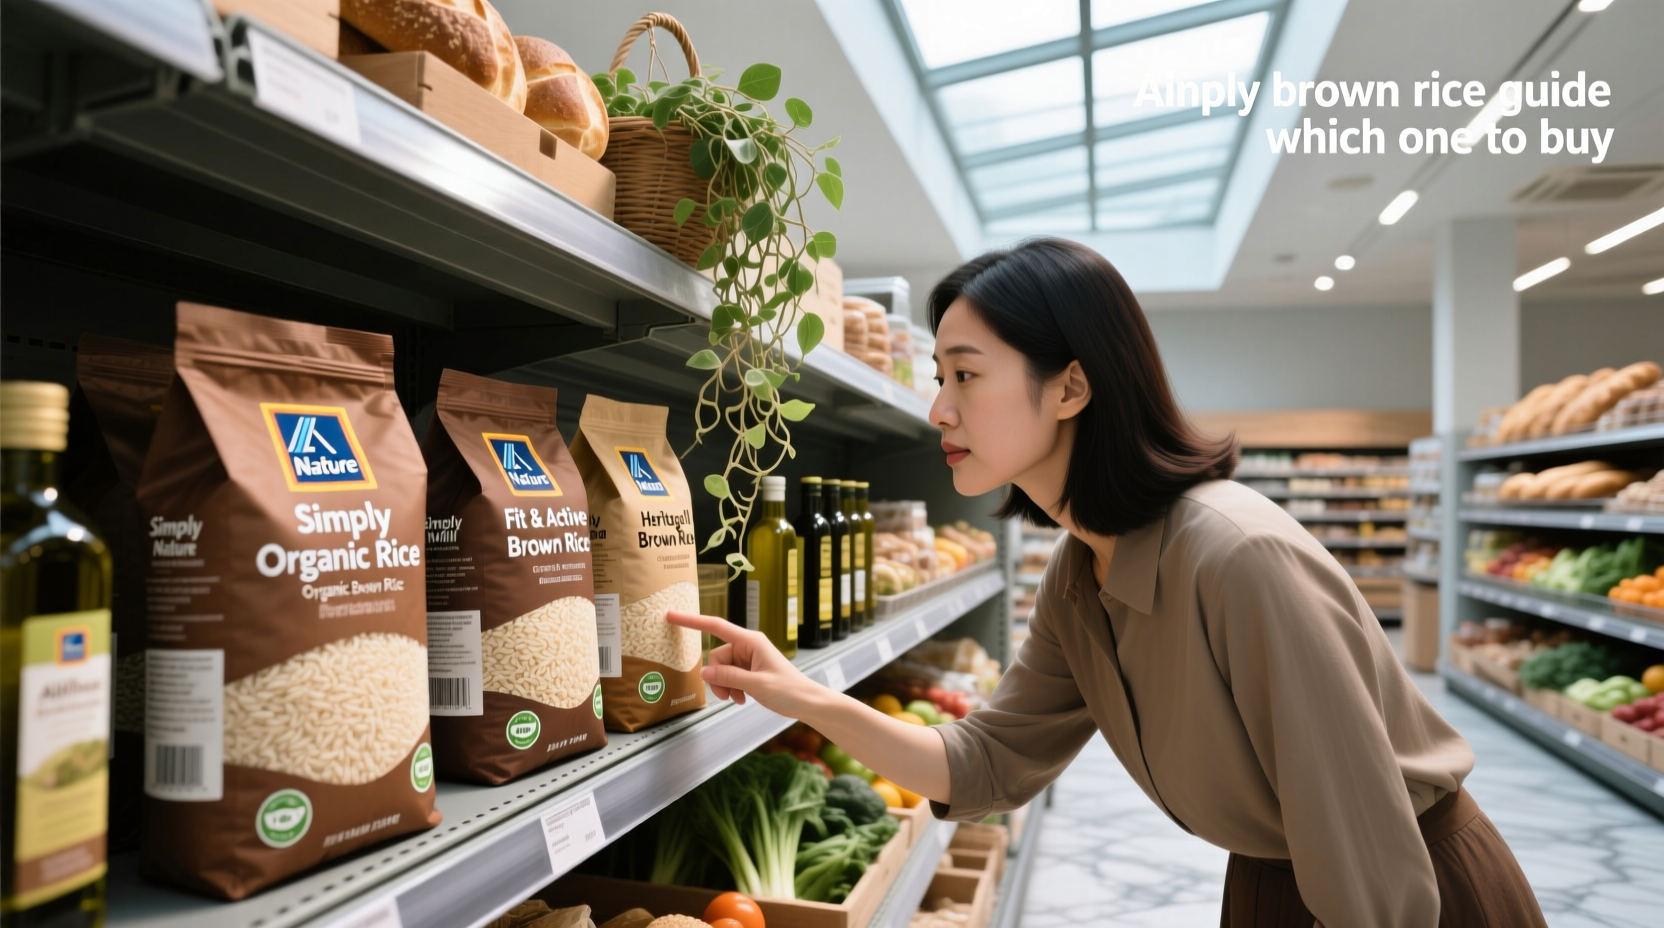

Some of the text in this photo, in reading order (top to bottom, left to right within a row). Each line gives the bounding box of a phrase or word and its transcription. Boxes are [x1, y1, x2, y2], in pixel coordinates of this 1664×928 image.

[293, 456, 359, 476] Nature
[149, 514, 203, 541] Simply
[294, 500, 391, 541] Simply
[504, 507, 528, 530] Fit
[530, 508, 545, 528] &
[547, 506, 588, 528] Active
[507, 536, 563, 558] Brown
[256, 539, 421, 583] Organic Rice
